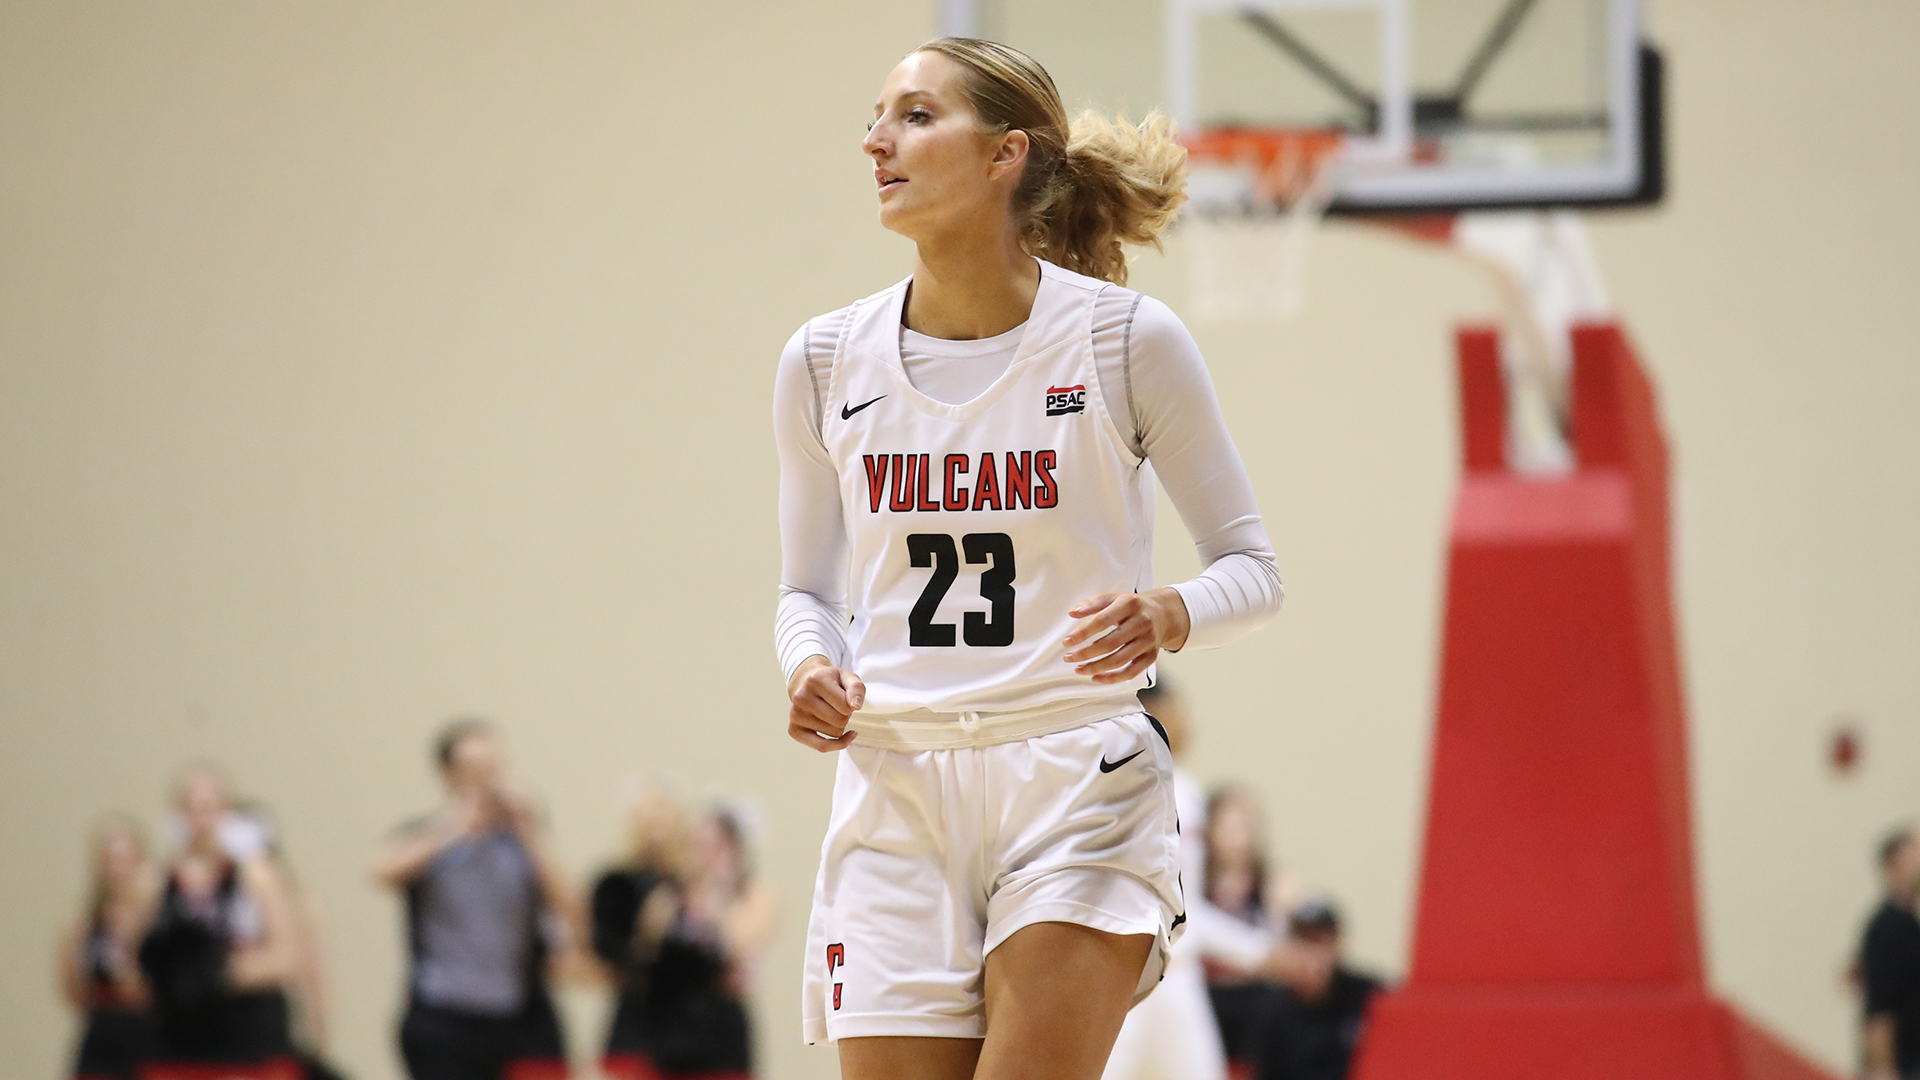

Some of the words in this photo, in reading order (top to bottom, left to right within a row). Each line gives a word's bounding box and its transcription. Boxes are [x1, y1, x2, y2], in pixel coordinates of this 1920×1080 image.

[1046, 391, 1086, 409] PSAC
[862, 449, 1059, 513] VULCANS
[906, 532, 1016, 647] 23
